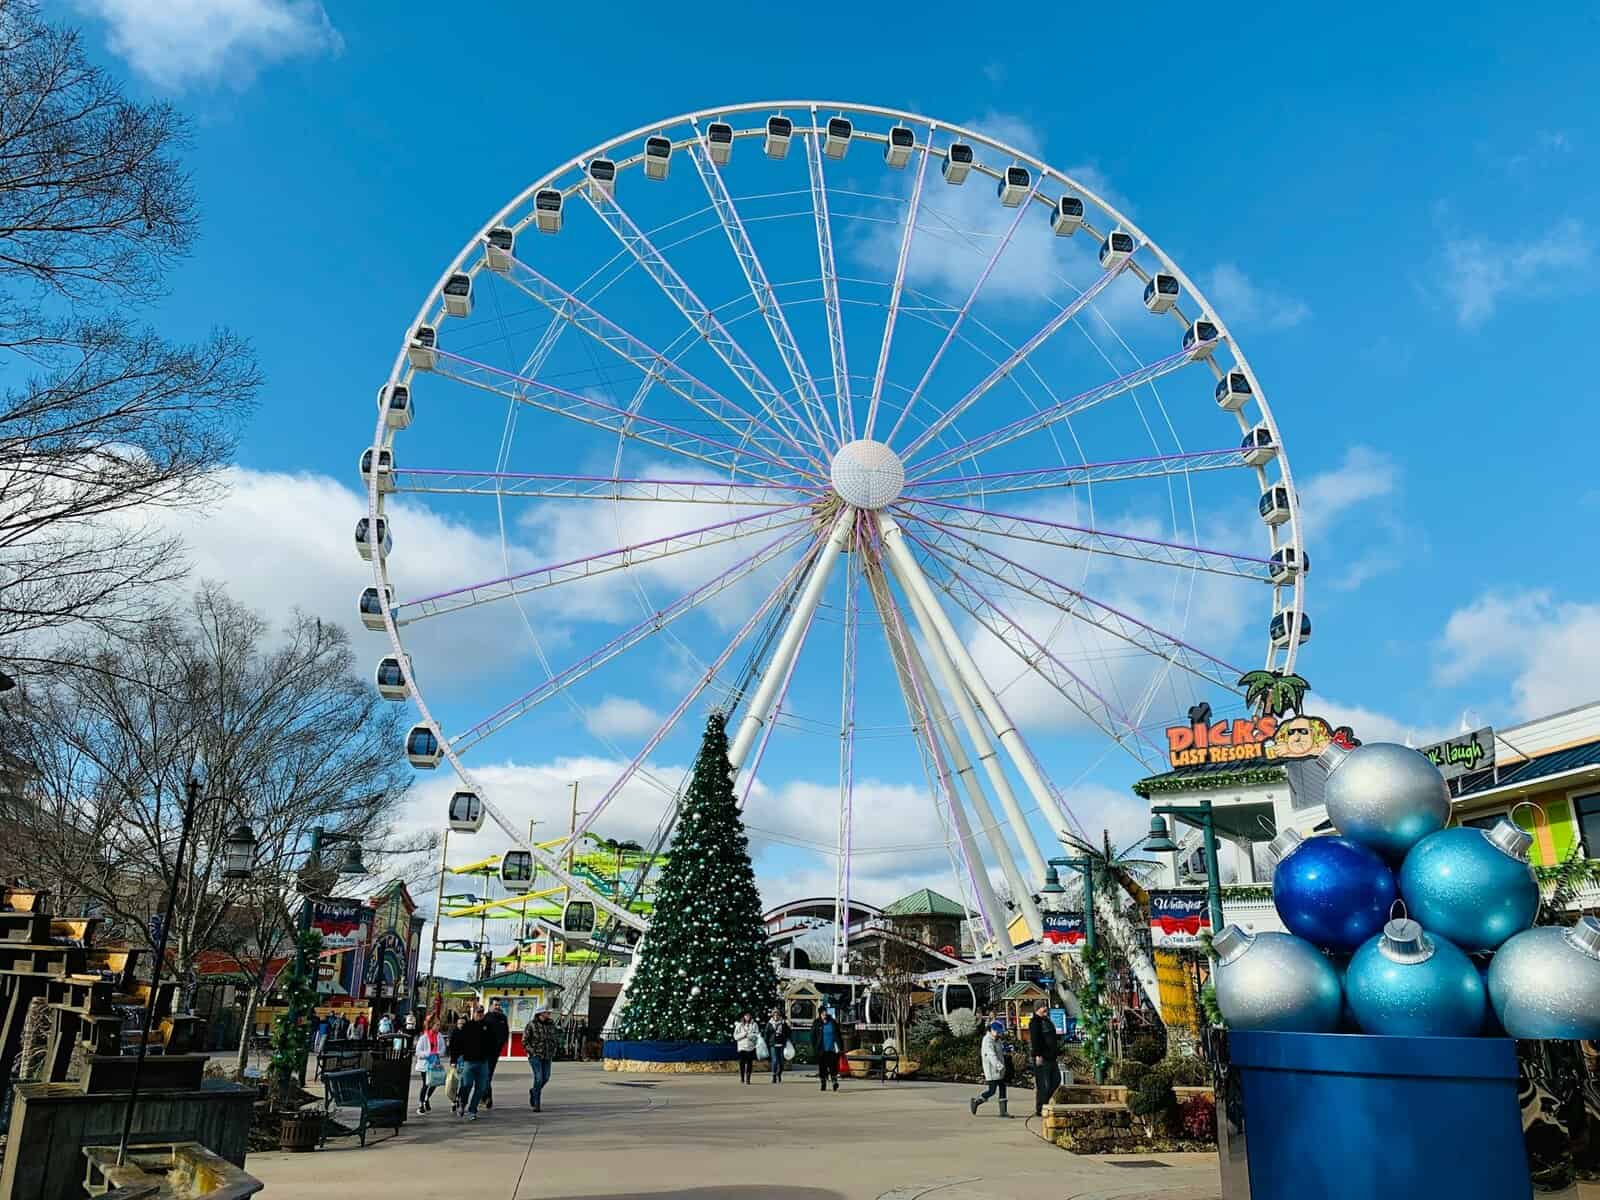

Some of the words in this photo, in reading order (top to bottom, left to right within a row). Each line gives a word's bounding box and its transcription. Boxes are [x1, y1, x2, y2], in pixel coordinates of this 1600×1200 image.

[1167, 715, 1278, 752] DICK'S
[1171, 748, 1206, 767] LAST
[1211, 742, 1263, 763] RESORT
[1446, 734, 1484, 769] laugh
[1154, 897, 1204, 912] Winterfest
